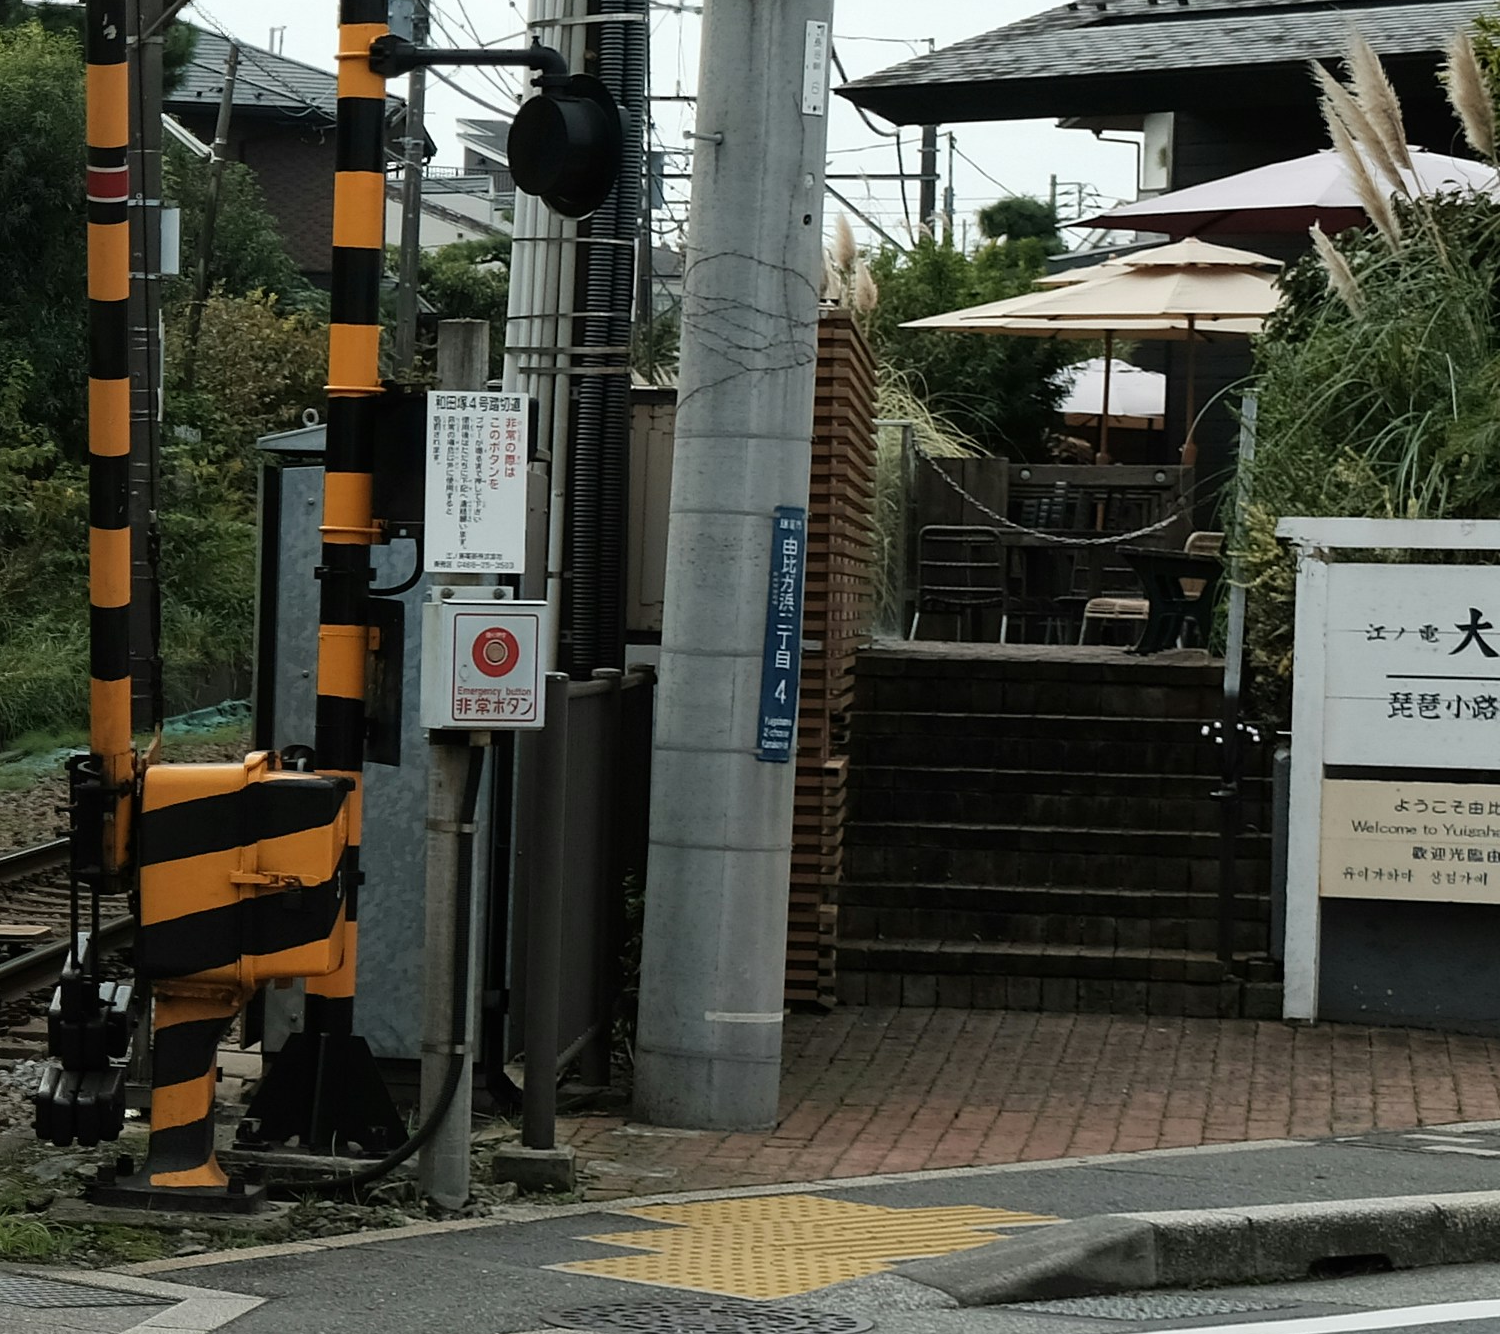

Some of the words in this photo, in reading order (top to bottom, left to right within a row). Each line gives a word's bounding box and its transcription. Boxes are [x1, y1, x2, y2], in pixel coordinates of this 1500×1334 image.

[488, 418, 500, 490] このボタンを
[505, 418, 517, 478] 非常の際は
[1366, 624, 1439, 644] 江ノ電
[1449, 607, 1500, 658] 大
[457, 686, 502, 697] Emergency
[506, 687, 532, 696] button
[775, 679, 787, 705] 4
[456, 698, 532, 715] 非常ボタン
[1388, 692, 1500, 720] 琵琶小路
[1352, 820, 1417, 836] Welcome
[1424, 824, 1438, 836] to
